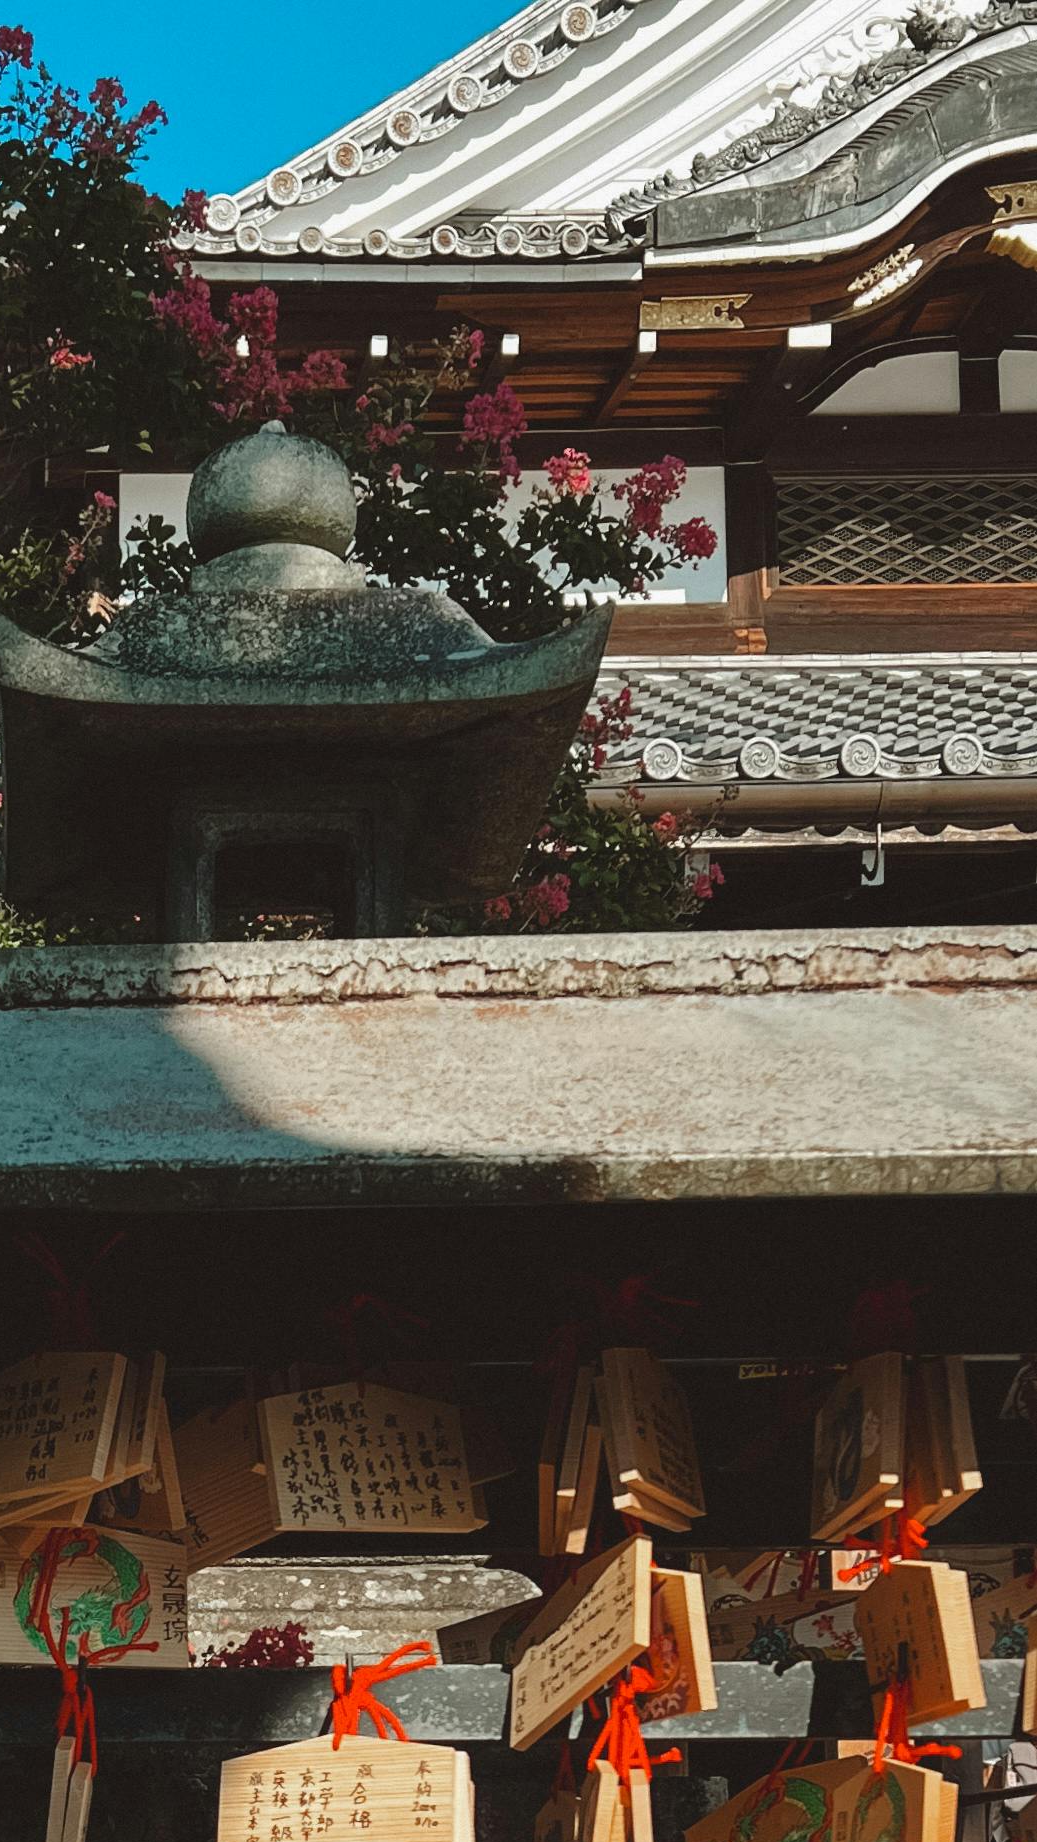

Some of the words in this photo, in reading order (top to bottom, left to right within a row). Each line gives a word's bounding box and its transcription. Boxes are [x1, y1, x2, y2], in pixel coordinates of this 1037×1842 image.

[299, 1768, 316, 1841] 京都大学
[317, 1771, 334, 1833] 工学部
[349, 1782, 373, 1828] 合格
[414, 1760, 432, 1798] 奉納
